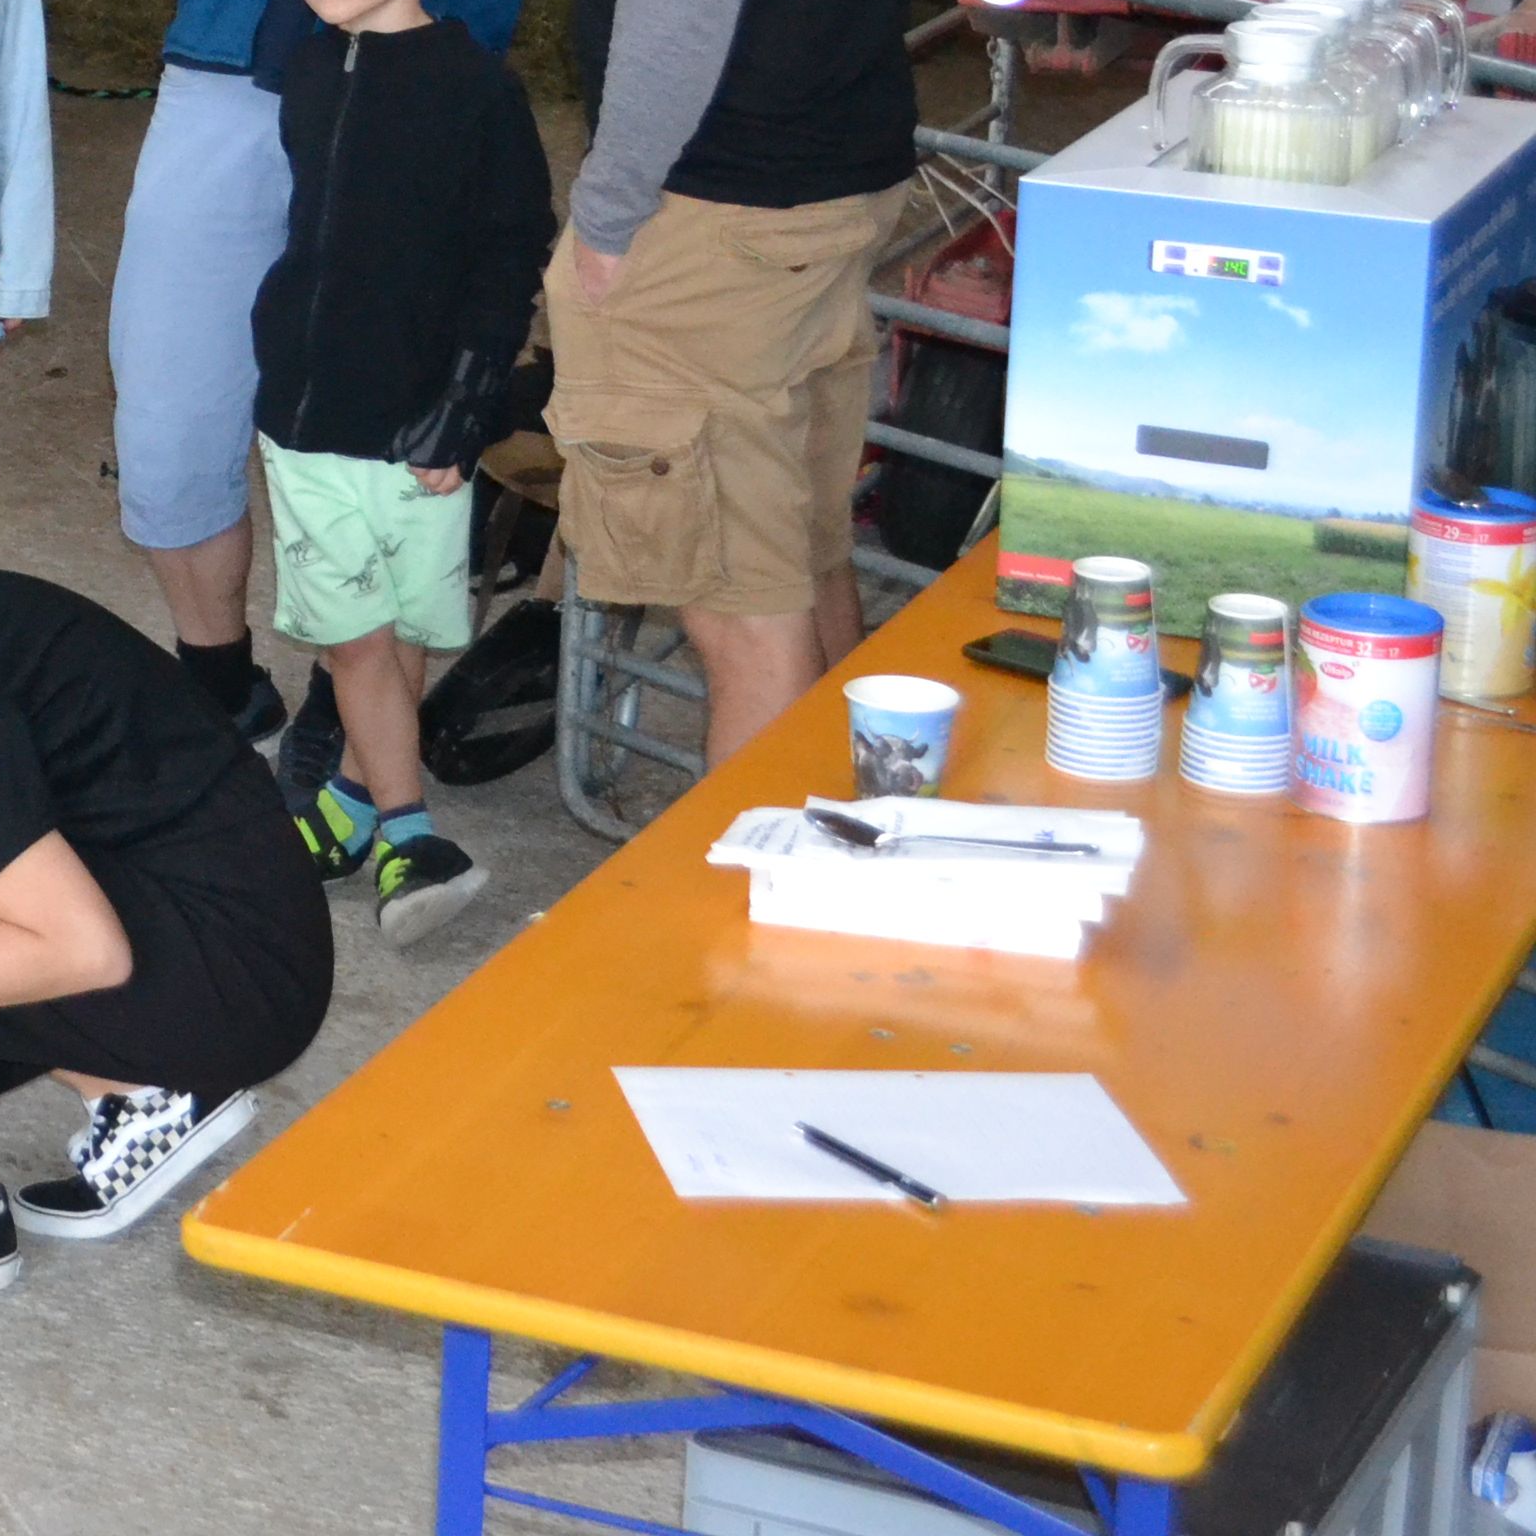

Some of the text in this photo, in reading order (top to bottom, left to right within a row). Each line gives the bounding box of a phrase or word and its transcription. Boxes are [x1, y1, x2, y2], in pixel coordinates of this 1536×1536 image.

[1443, 524, 1460, 540] 29
[1356, 641, 1373, 656] 32
[1303, 730, 1366, 765] MILK
[1296, 754, 1374, 794] SHAKE
